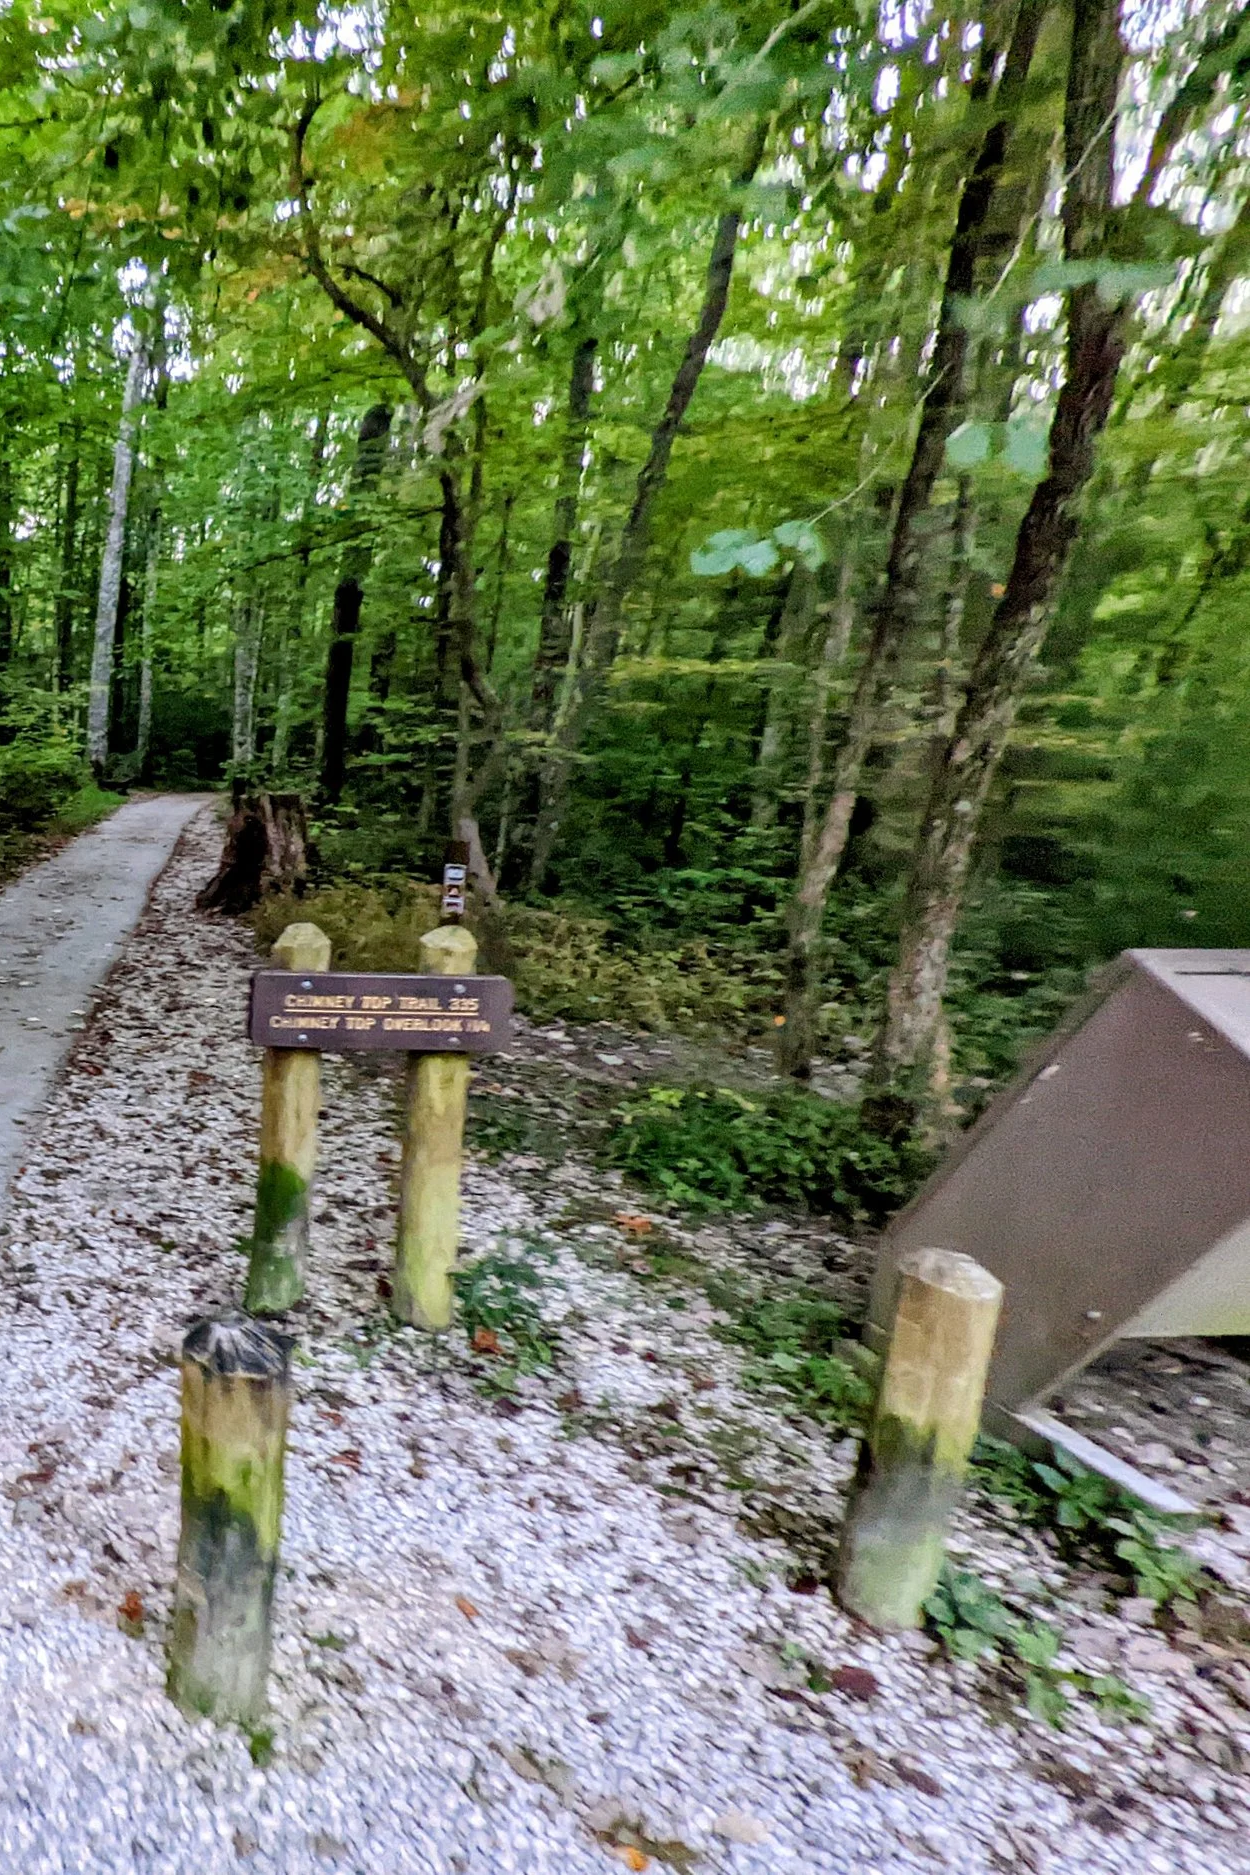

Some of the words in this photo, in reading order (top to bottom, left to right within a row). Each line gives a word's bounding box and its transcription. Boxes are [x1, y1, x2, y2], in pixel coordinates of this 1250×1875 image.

[284, 994, 356, 1009] CHIMNEY
[361, 995, 392, 1010] TOP
[398, 996, 443, 1011] TRAIL
[269, 1015, 340, 1030] CHIMNEY
[345, 1016, 377, 1031] TOP
[382, 1018, 463, 1032] OVERLOOK
